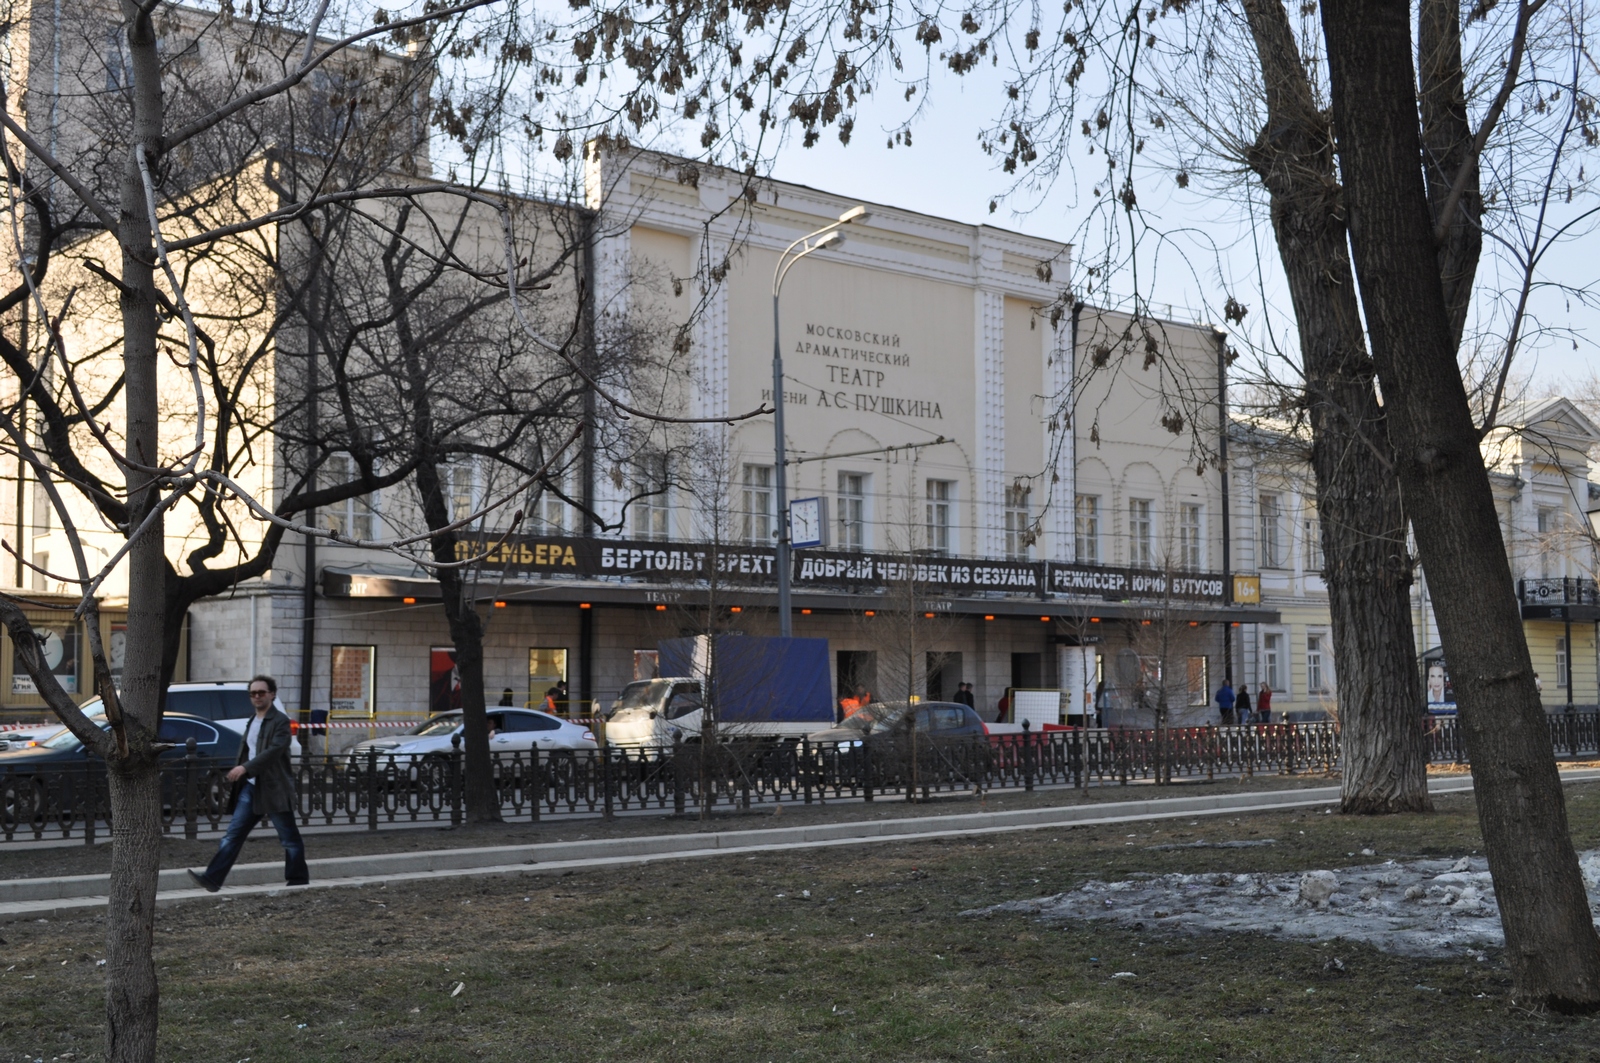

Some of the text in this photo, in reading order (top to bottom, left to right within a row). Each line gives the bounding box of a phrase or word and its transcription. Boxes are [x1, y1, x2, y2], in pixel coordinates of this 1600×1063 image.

[806, 323, 901, 348] МОСКОВСКИЙ
[795, 341, 911, 368] ДРАМАТИЧЕСКИЙ
[825, 364, 885, 388] ТЕАТР
[761, 389, 808, 406] ИЕНИ
[855, 393, 944, 420] ПУШКИНА
[601, 547, 706, 571] БЕРТОЛЬТ
[800, 556, 1037, 587] ДОБРЫЙ ЧЕЛОВЕК ИЗ СЕЗУАНА
[1054, 569, 1129, 591] РЕЖИССЕР:
[1172, 578, 1223, 596] БУТУСОВ
[343, 582, 368, 594] ТЕАТР
[645, 591, 681, 602] ТЕАТР
[1237, 581, 1256, 597] 16+
[924, 600, 952, 611] ТЕАТР
